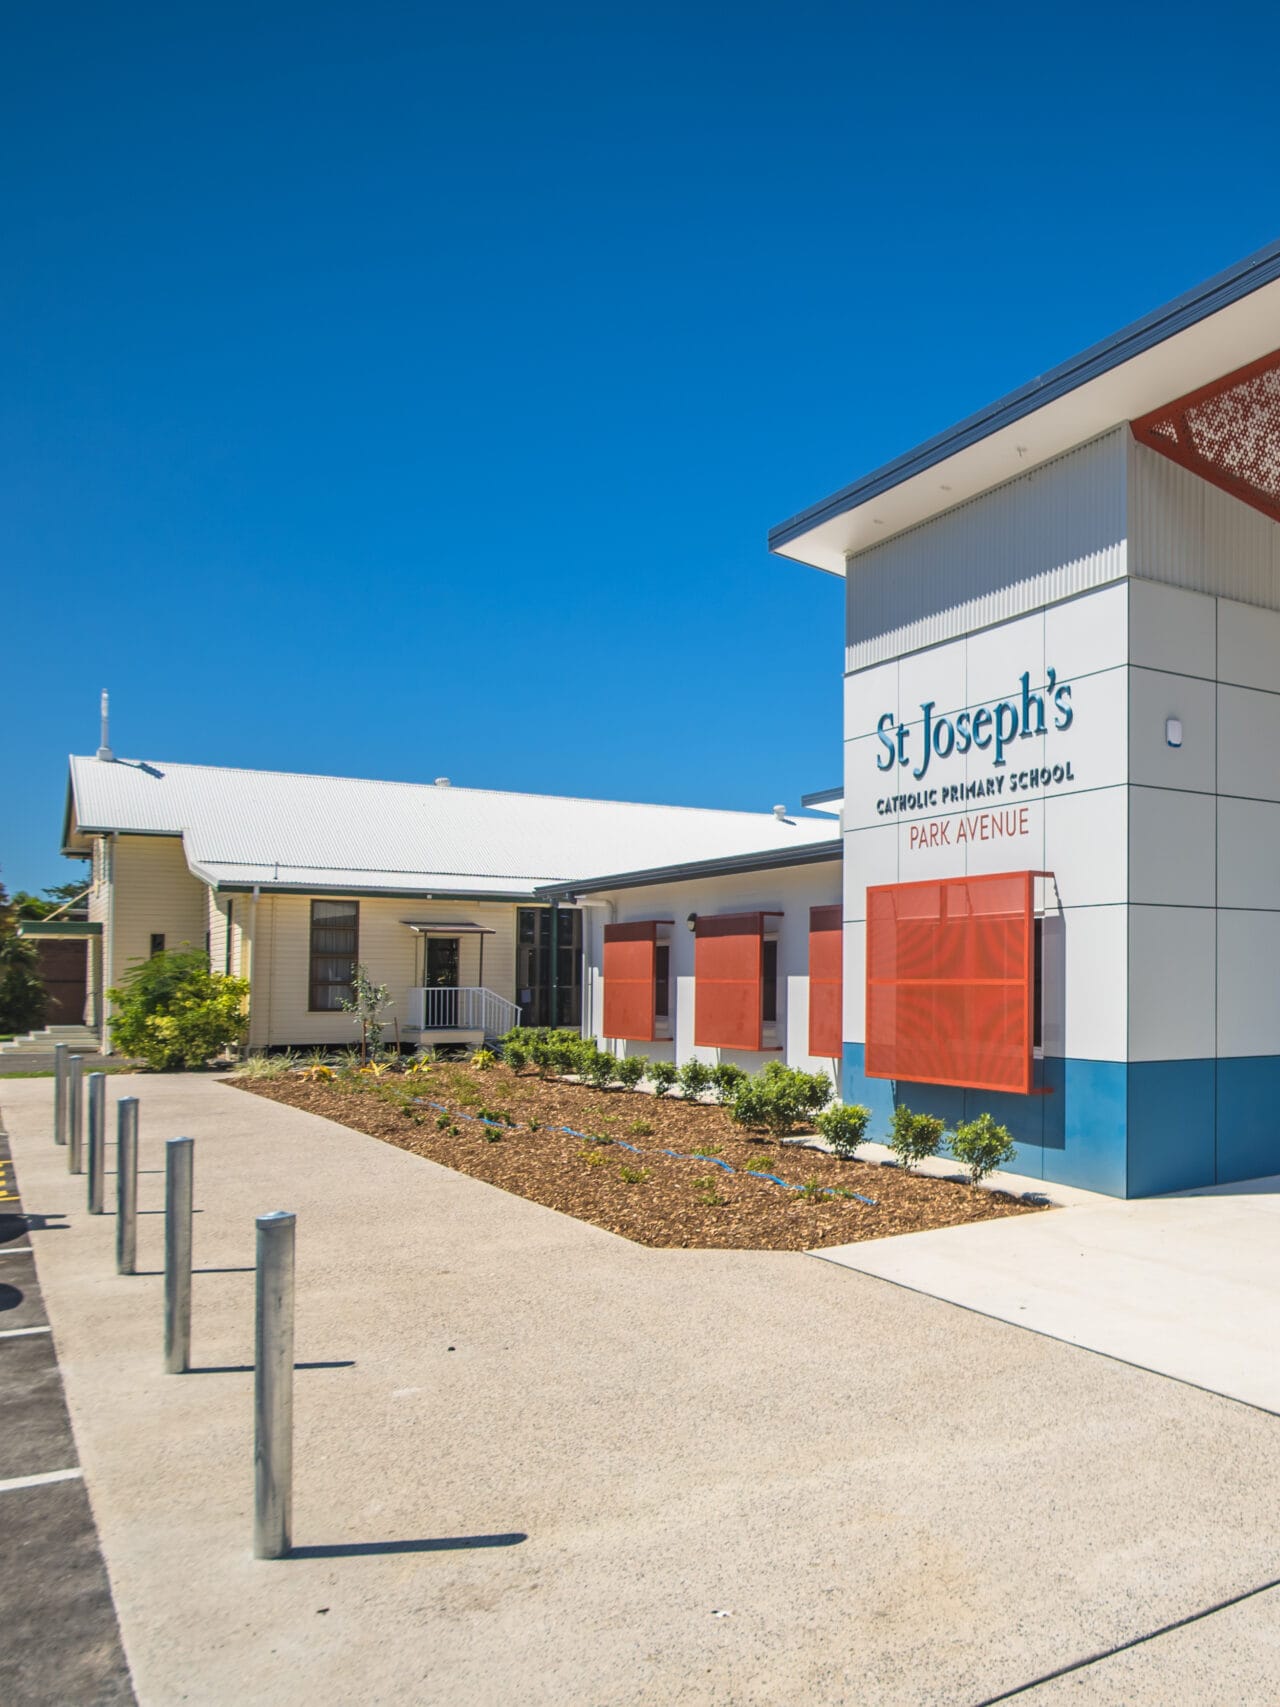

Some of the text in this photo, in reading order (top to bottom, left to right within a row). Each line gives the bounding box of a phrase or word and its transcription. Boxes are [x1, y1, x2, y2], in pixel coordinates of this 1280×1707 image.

[877, 666, 1074, 781] St Joseph's
[877, 761, 1074, 815] CATHOLIC PRIMARY SCHOOL
[910, 808, 1029, 850] PARK AVENUE
